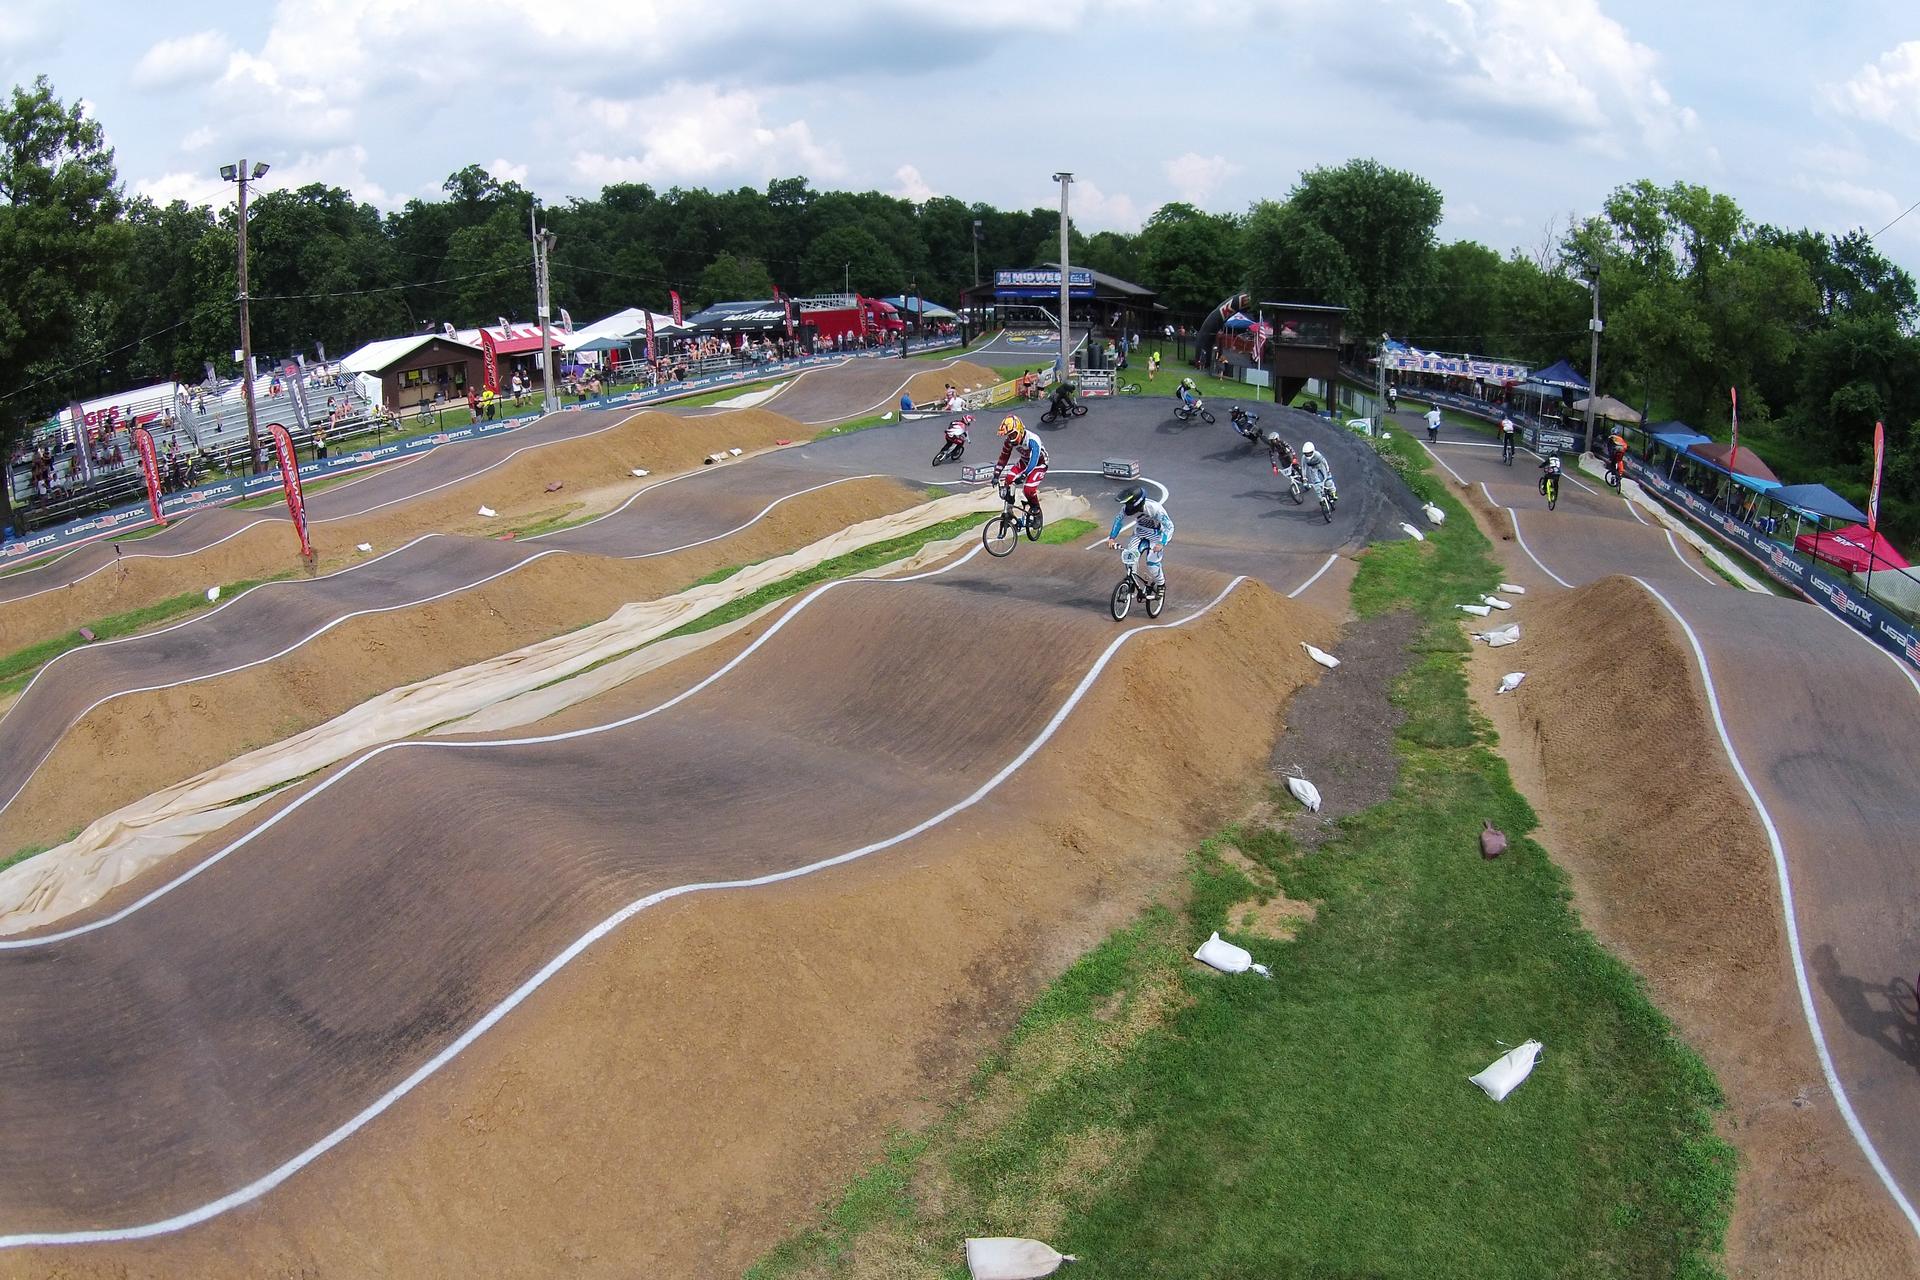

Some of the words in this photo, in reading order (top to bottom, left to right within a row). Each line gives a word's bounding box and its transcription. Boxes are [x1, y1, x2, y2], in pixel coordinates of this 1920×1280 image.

[1398, 357, 1515, 378] FINISH
[479, 422, 503, 432] USA
[406, 438, 431, 449] USA
[448, 428, 472, 438] BMX
[327, 456, 354, 467] USA
[373, 445, 399, 456] BMX
[203, 484, 232, 496] BMX
[244, 474, 273, 487] USA
[64, 522, 96, 536] USA
[115, 507, 145, 523] BMX
[1709, 510, 1724, 524] USA
[1733, 524, 1750, 540] BMX
[26, 533, 57, 548] BMX
[1754, 537, 1771, 554] USA
[1782, 556, 1804, 575] BMX
[1810, 574, 1833, 596] USA
[1846, 599, 1873, 623] BMX
[1880, 620, 1908, 648] USA
